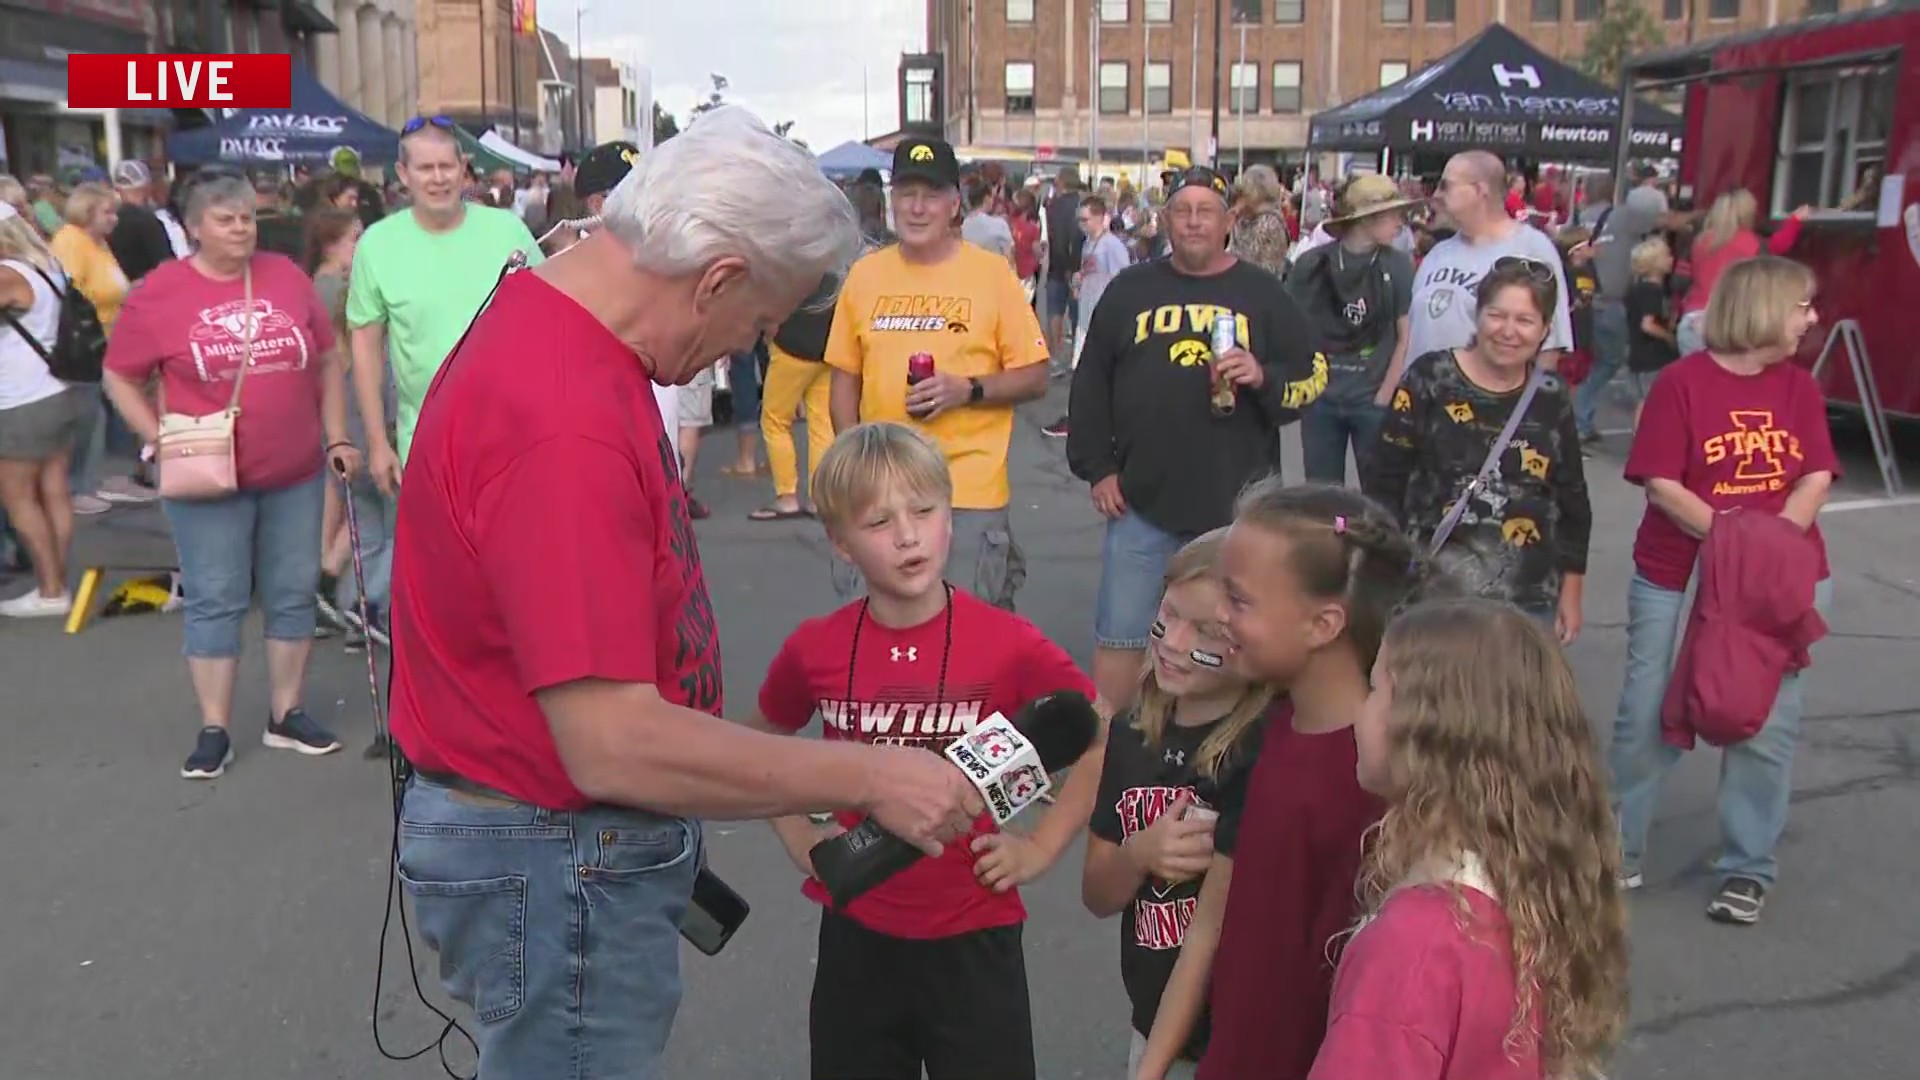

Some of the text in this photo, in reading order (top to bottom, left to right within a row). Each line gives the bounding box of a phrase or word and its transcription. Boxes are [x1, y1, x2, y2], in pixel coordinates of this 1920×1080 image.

[249, 114, 348, 133] DMACC
[1541, 125, 1609, 142] Newton
[1629, 128, 1669, 146] Iowa
[220, 137, 287, 160] DMACC
[870, 295, 972, 323] IOWA
[870, 316, 947, 332] HAWKEYES
[1712, 481, 1767, 495] Alumni
[820, 698, 984, 734] NEWTON
[952, 744, 989, 780] NEWS
[985, 781, 1012, 820] NEWS
